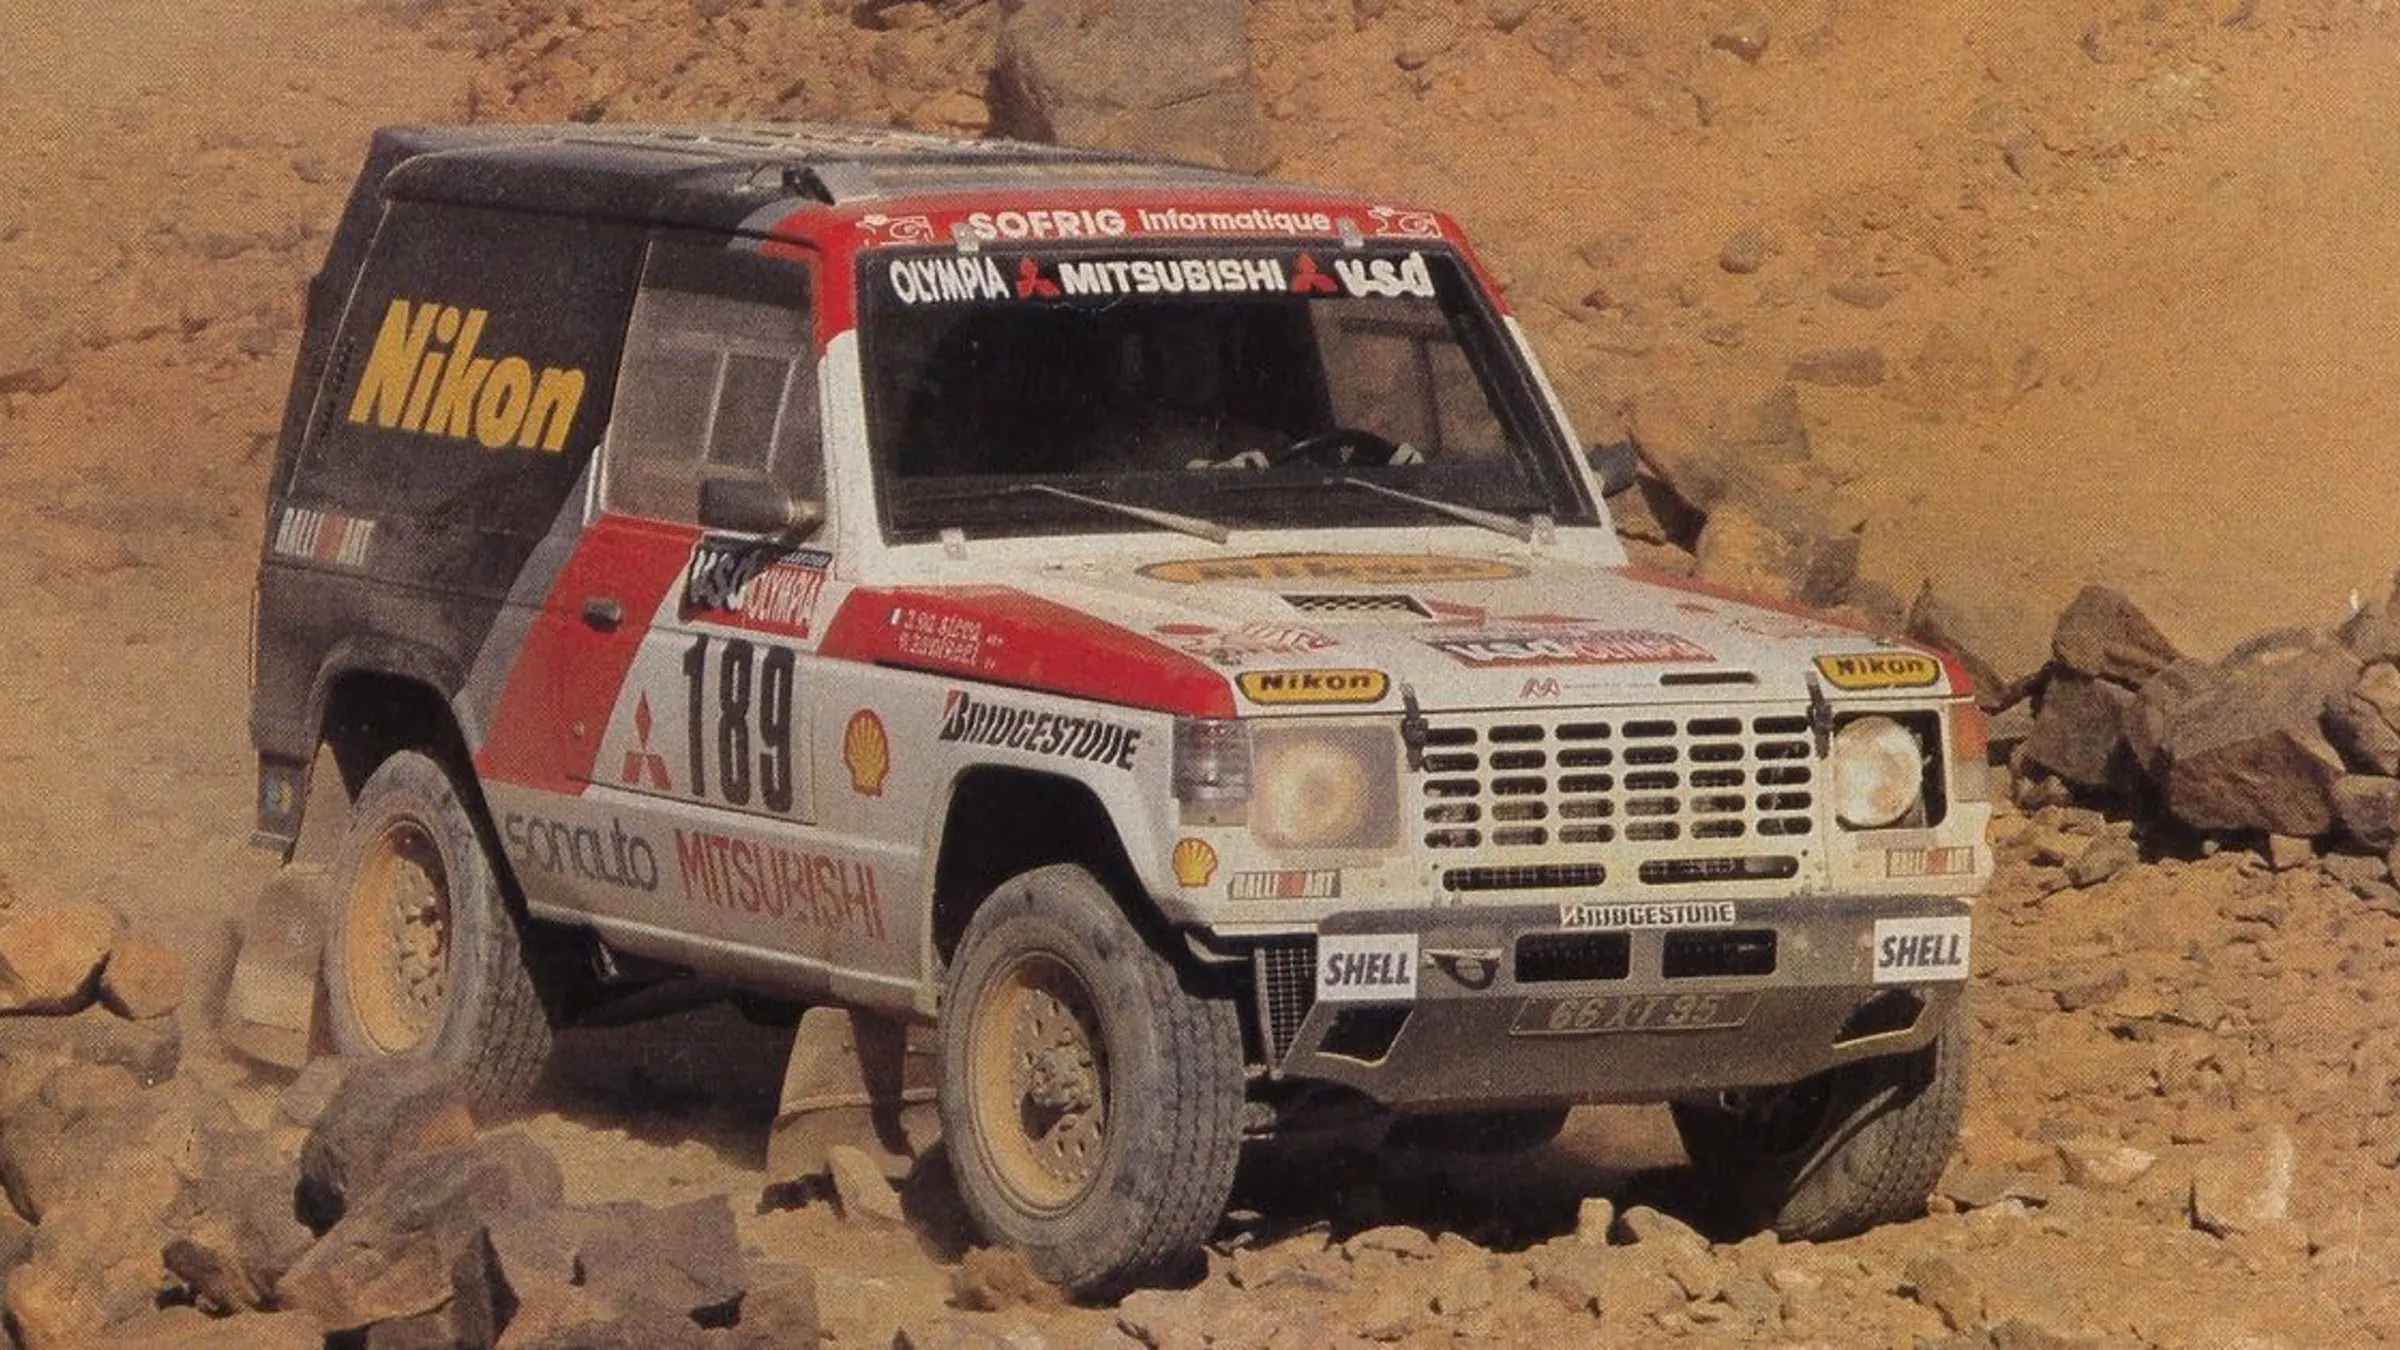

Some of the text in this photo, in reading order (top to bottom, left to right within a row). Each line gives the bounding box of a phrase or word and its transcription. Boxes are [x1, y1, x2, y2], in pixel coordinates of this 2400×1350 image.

[968, 209, 1330, 240] SOFRIG Informatique
[889, 256, 1011, 304] OLYMPIA
[1057, 258, 1288, 295] MITSUBISHI
[347, 298, 586, 452] Nikon
[1260, 673, 1371, 691] Nikon
[1835, 657, 1924, 676] Nikon
[682, 633, 796, 813] 189
[940, 688, 1142, 772] BRIDGESTONE
[505, 812, 660, 893] sonauto
[674, 828, 885, 941] MITSUBISHI
[1561, 902, 1735, 926] BRIDGESTONE
[1324, 952, 1411, 986] SHELL
[1878, 933, 1963, 968] SHELL
